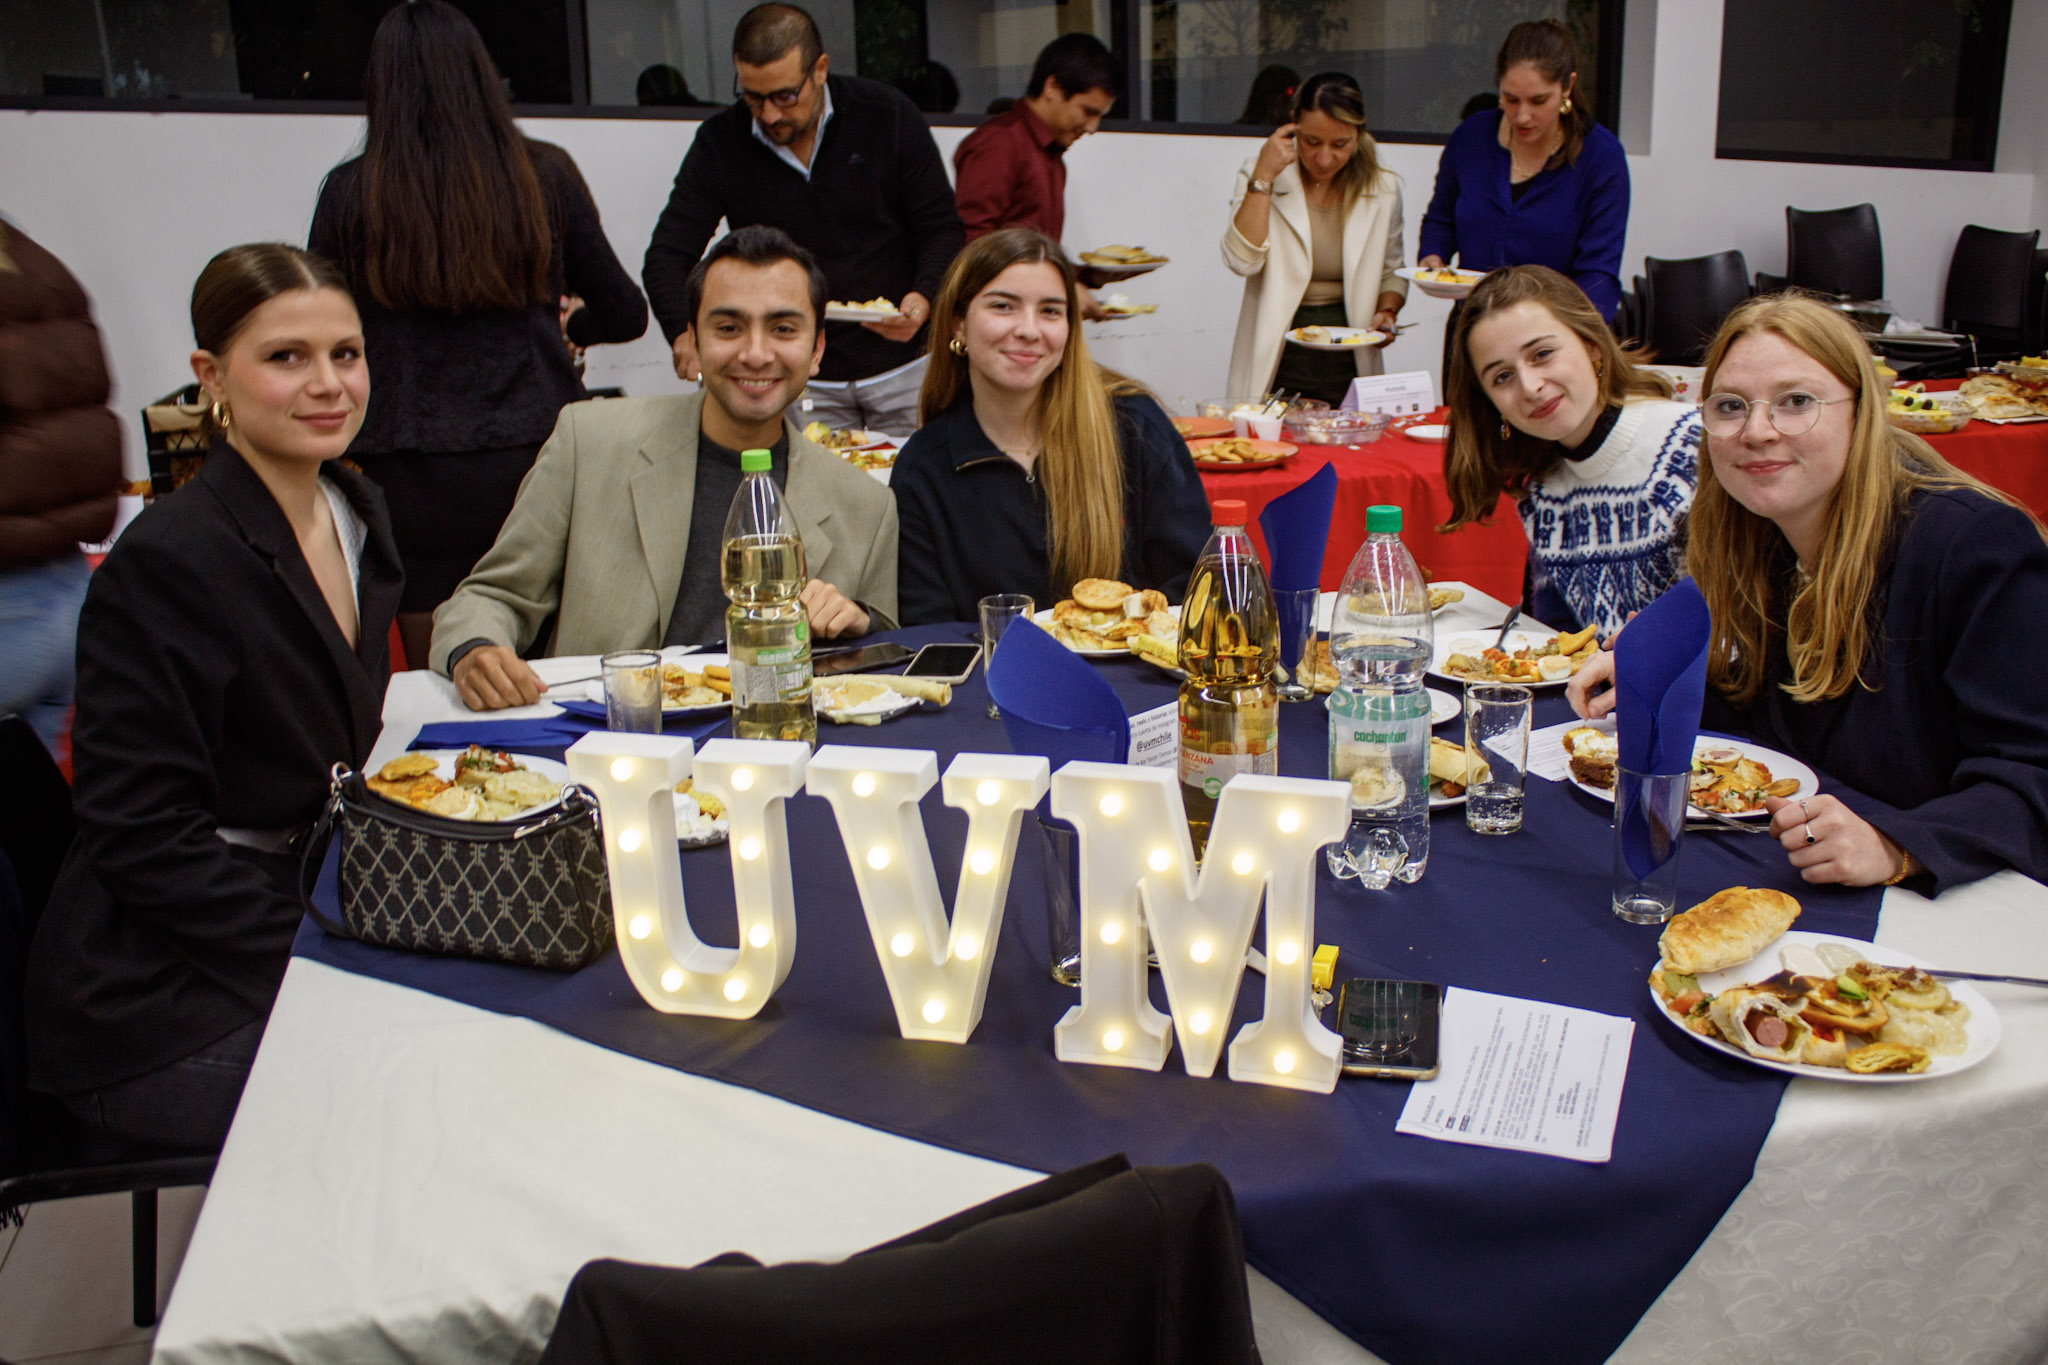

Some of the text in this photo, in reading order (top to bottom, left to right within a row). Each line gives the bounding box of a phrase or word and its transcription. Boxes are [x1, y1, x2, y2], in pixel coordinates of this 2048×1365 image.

[1136, 731, 1173, 752] @uvmchile
[1354, 730, 1407, 743] cachantun
[565, 730, 1351, 1093] UVM
